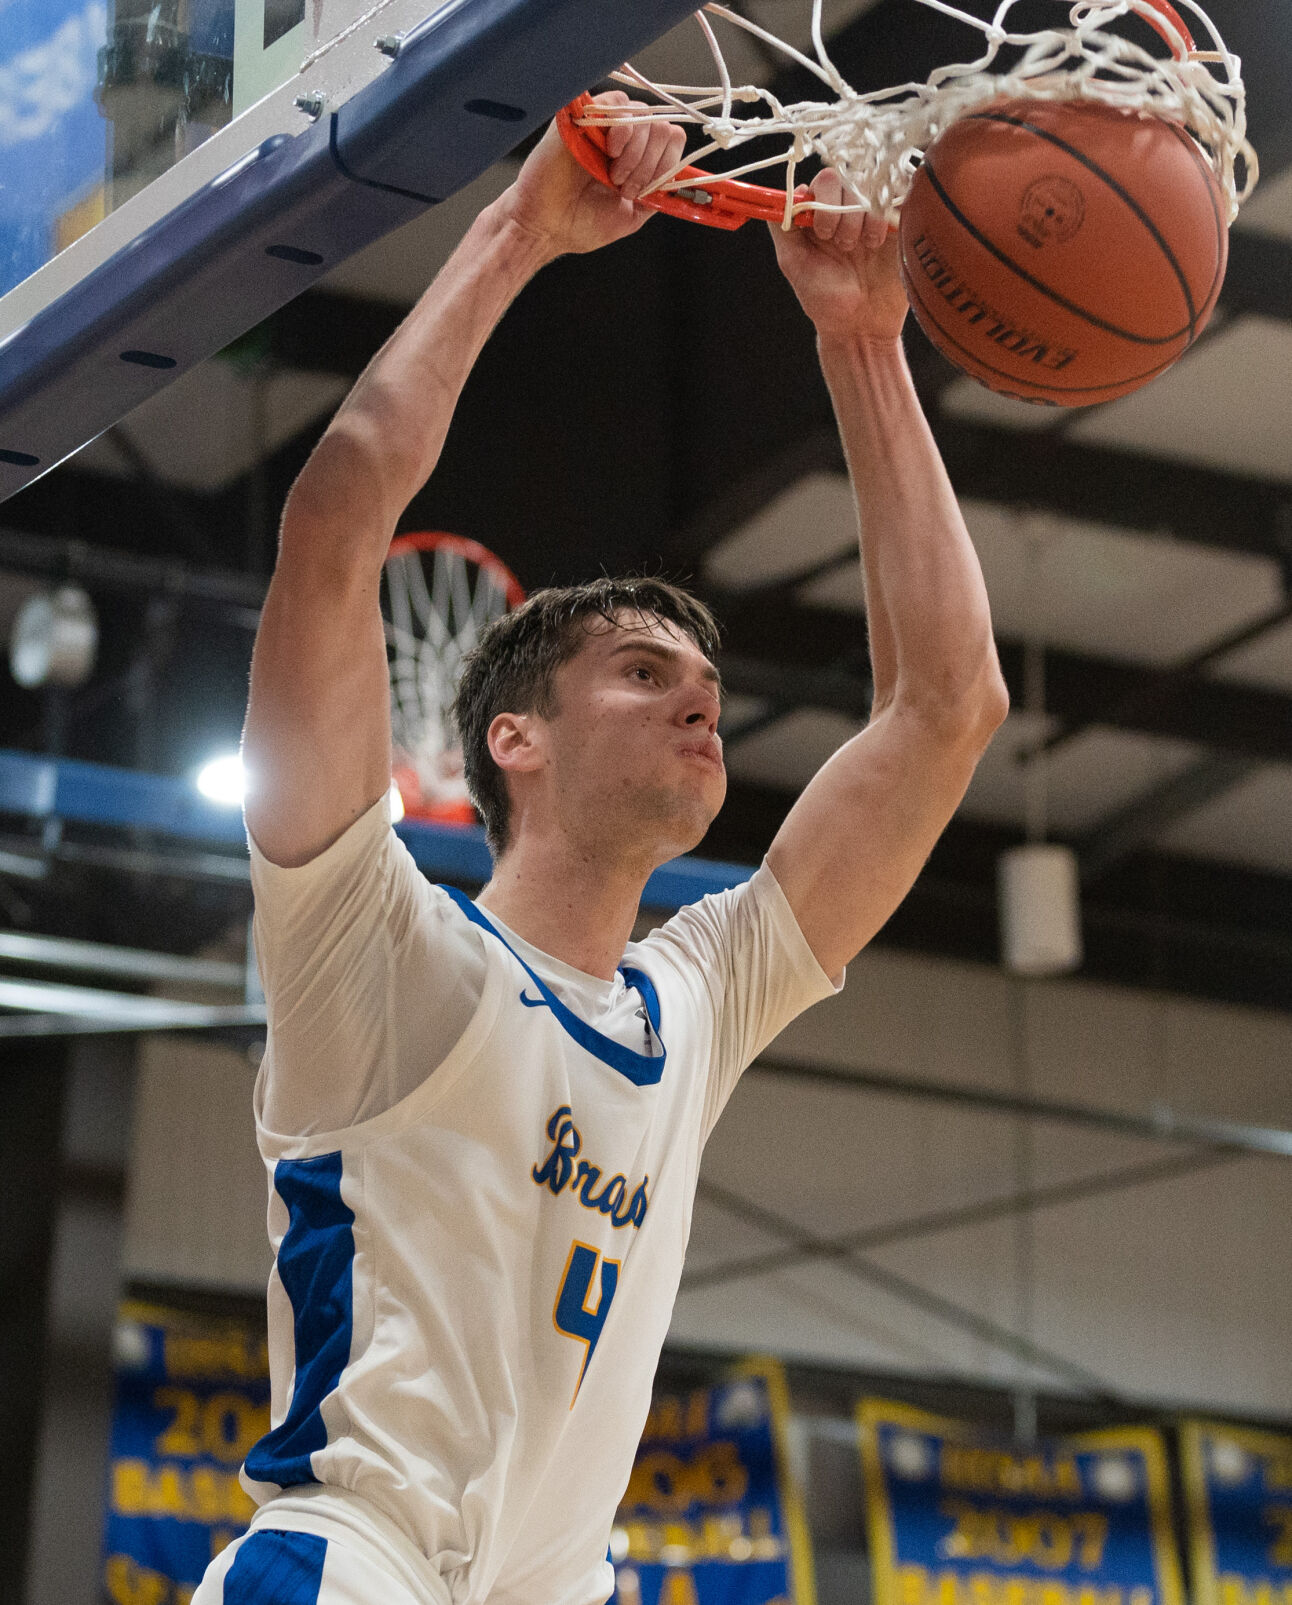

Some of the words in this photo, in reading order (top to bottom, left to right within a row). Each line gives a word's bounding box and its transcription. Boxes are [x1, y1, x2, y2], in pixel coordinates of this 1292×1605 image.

[913, 233, 1078, 371] EVOLUTION
[551, 1238, 621, 1412] 4
[153, 1387, 270, 1461] 20
